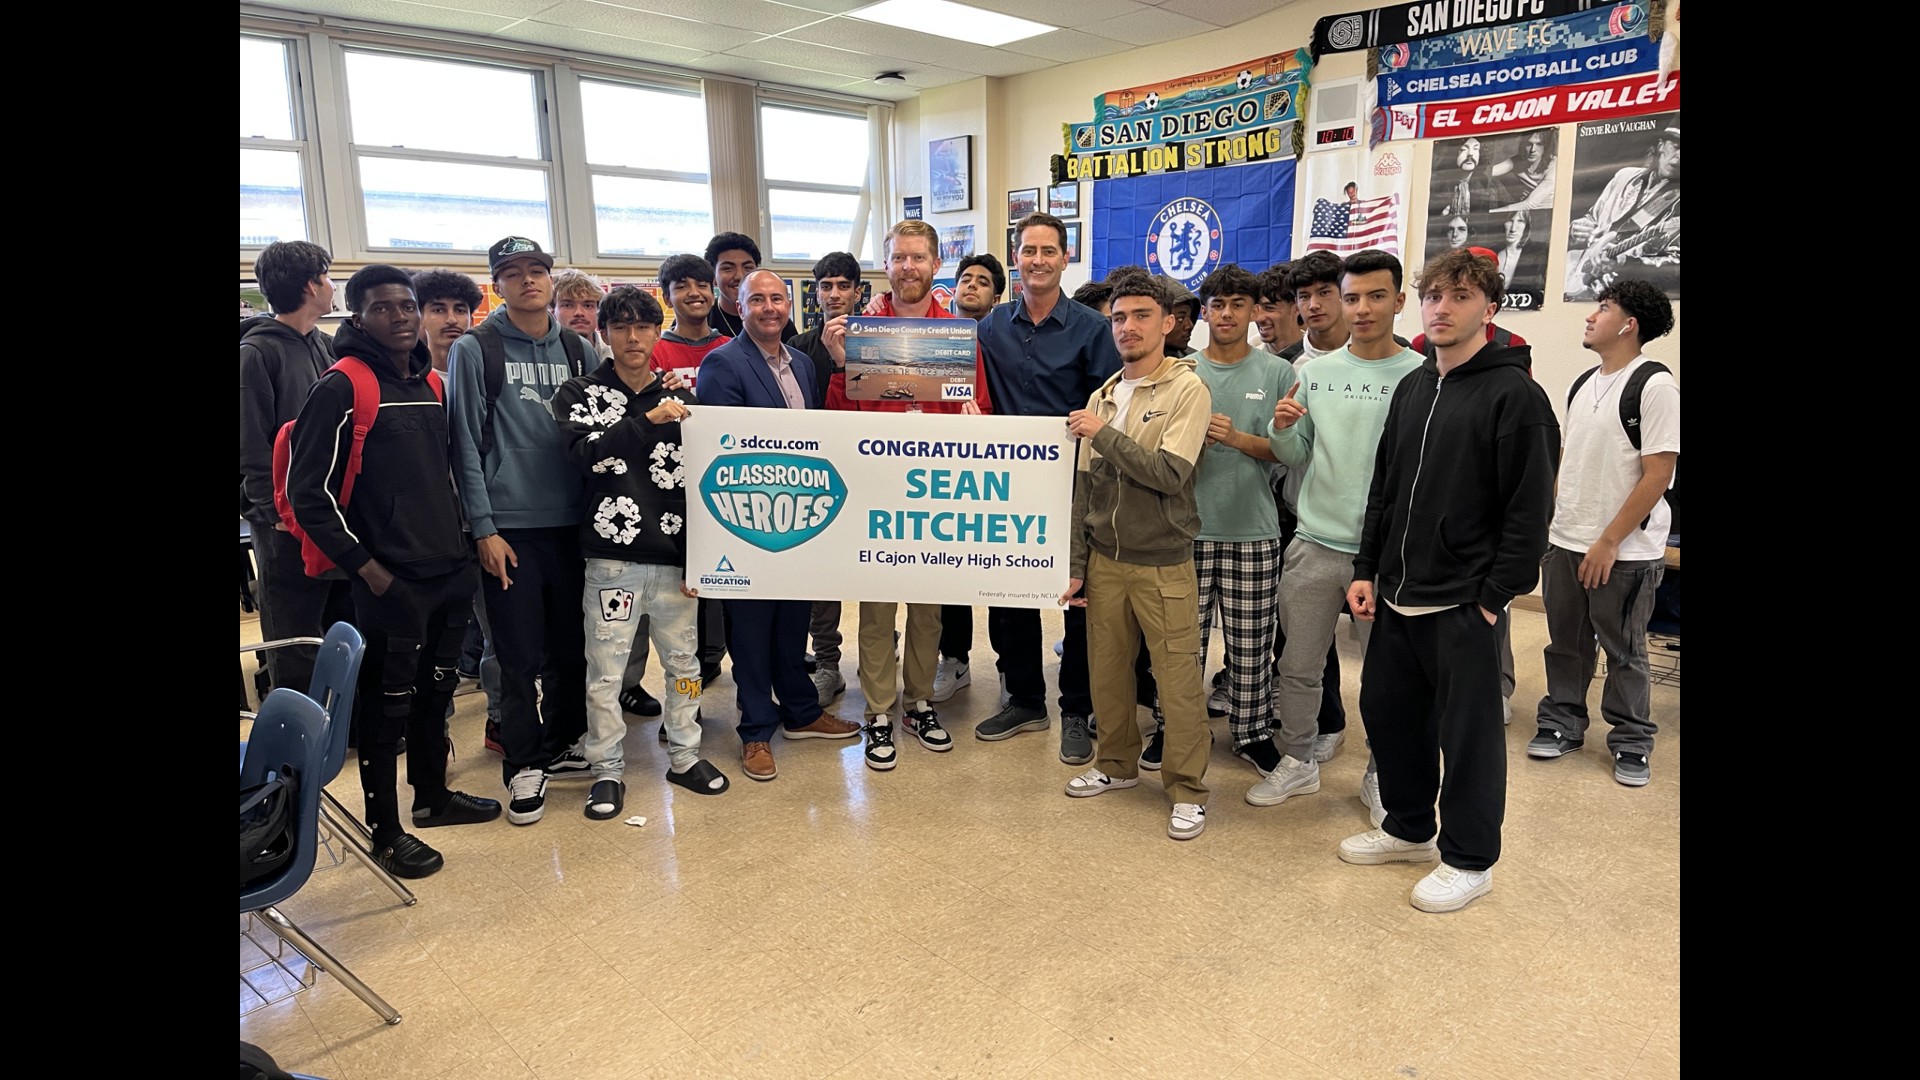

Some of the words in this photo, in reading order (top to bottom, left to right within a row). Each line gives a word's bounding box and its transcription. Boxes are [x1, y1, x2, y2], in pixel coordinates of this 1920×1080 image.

[1407, 2, 1452, 37] SAN
[1452, 0, 1514, 25] DIEGO
[1516, 0, 1545, 15] FC
[1460, 27, 1519, 57] WAVE
[1527, 24, 1552, 47] FC
[1406, 73, 1483, 93] CHELSEA
[1486, 58, 1581, 86] FOOTBALL
[1586, 48, 1638, 70] CLUB
[1432, 109, 1462, 128] EL
[1472, 94, 1552, 123] CAJON
[1567, 79, 1677, 111] VALLEY
[1100, 119, 1153, 146] SAN
[1161, 100, 1259, 138] DIEGO
[1394, 110, 1415, 130] ECV
[1580, 124, 1604, 137] STEVIE
[1604, 123, 1620, 134] RAY
[1620, 119, 1657, 133] VAUGHAN
[1321, 127, 1354, 143] 10:10
[1067, 147, 1179, 180] BATTALION
[1187, 128, 1281, 167] STRONG
[1374, 166, 1401, 176] Kappa
[905, 208, 921, 218] WAVE
[1160, 201, 1210, 224] CHELSEA
[1191, 271, 1208, 286] CLUB
[863, 325, 878, 333] San
[878, 325, 900, 335] Diego
[901, 326, 927, 336] County
[927, 326, 949, 334] Credit
[950, 327, 972, 335] Union
[505, 362, 568, 385] PUMA
[944, 386, 972, 397] VISA
[1245, 392, 1263, 400] PUMA
[1310, 382, 1390, 395] BLAKE
[1344, 394, 1383, 402] ORIGINAL
[740, 435, 819, 451] sdccu.com
[857, 438, 1060, 461] CONGRATULATIONS
[716, 464, 830, 490] CLASSROOM
[905, 468, 1011, 502] SEAN
[710, 491, 834, 533] HEROES
[868, 509, 1047, 545] RITCHEY!
[859, 550, 872, 563] El
[876, 551, 917, 568] Cajon
[920, 552, 963, 568] Valley
[967, 553, 1001, 570] High
[1005, 555, 1055, 569] School
[700, 577, 751, 586] EDUCATION
[978, 590, 1006, 599] Federally
[1031, 592, 1040, 600] by
